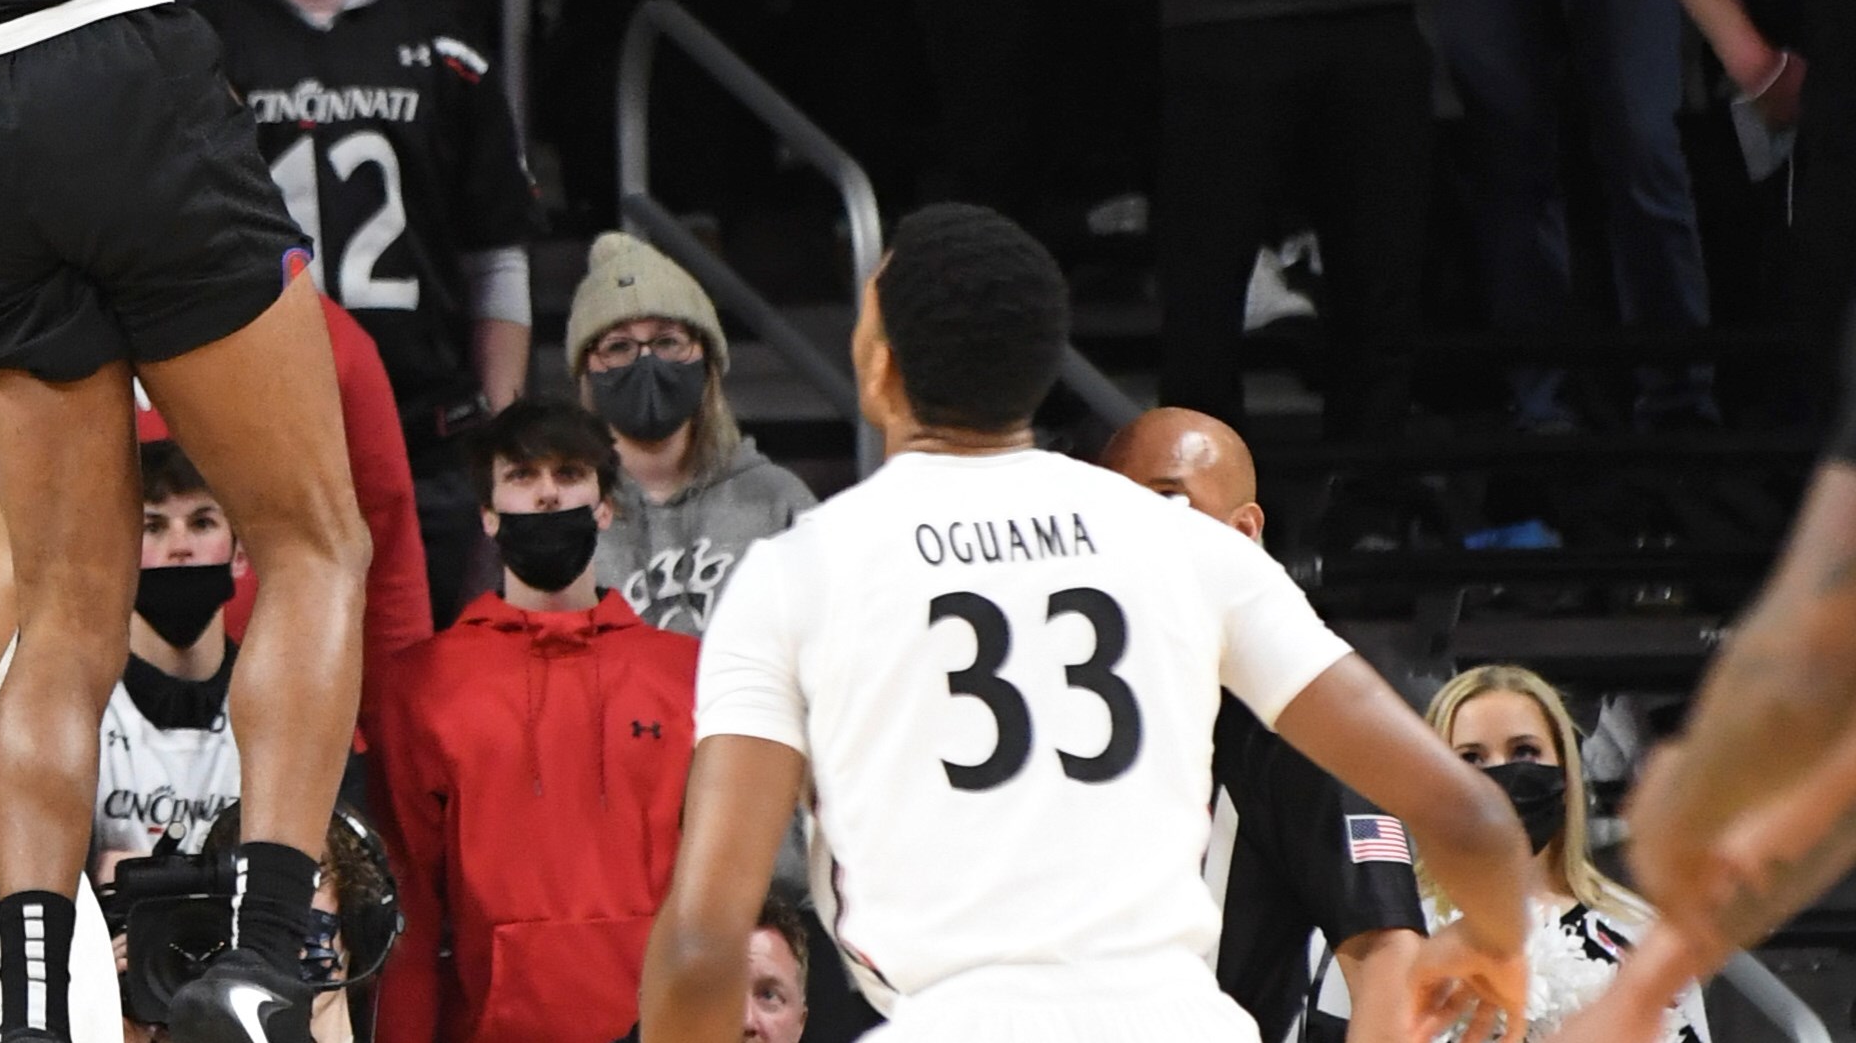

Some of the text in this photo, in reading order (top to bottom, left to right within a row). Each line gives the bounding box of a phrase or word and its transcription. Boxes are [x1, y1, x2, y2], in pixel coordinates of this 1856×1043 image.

[269, 128, 420, 311] 12
[914, 512, 1098, 566] OGUAMA
[928, 586, 1144, 792] 33
